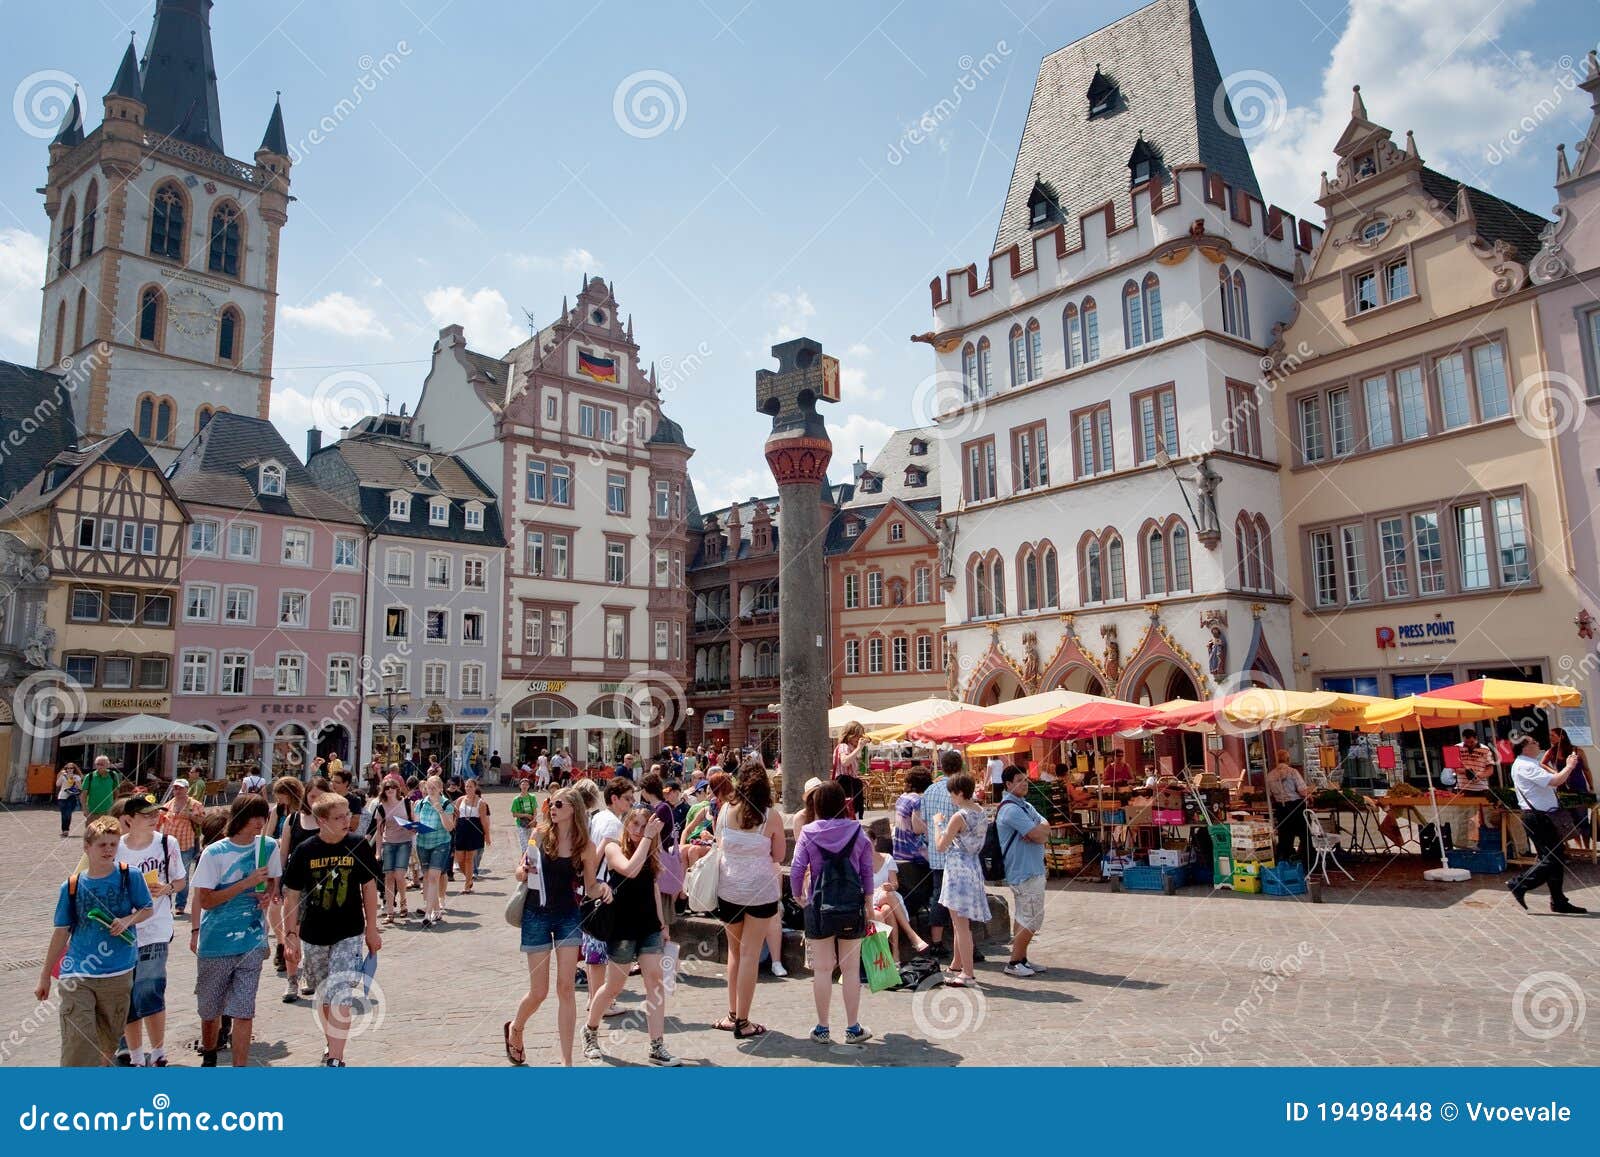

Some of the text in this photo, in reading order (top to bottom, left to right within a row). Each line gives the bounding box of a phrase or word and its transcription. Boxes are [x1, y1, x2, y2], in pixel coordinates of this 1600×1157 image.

[1398, 620, 1455, 639] PRESS POINT
[528, 681, 568, 692] SUBWAY
[136, 699, 162, 708] HAUS
[171, 731, 196, 740] HAUS
